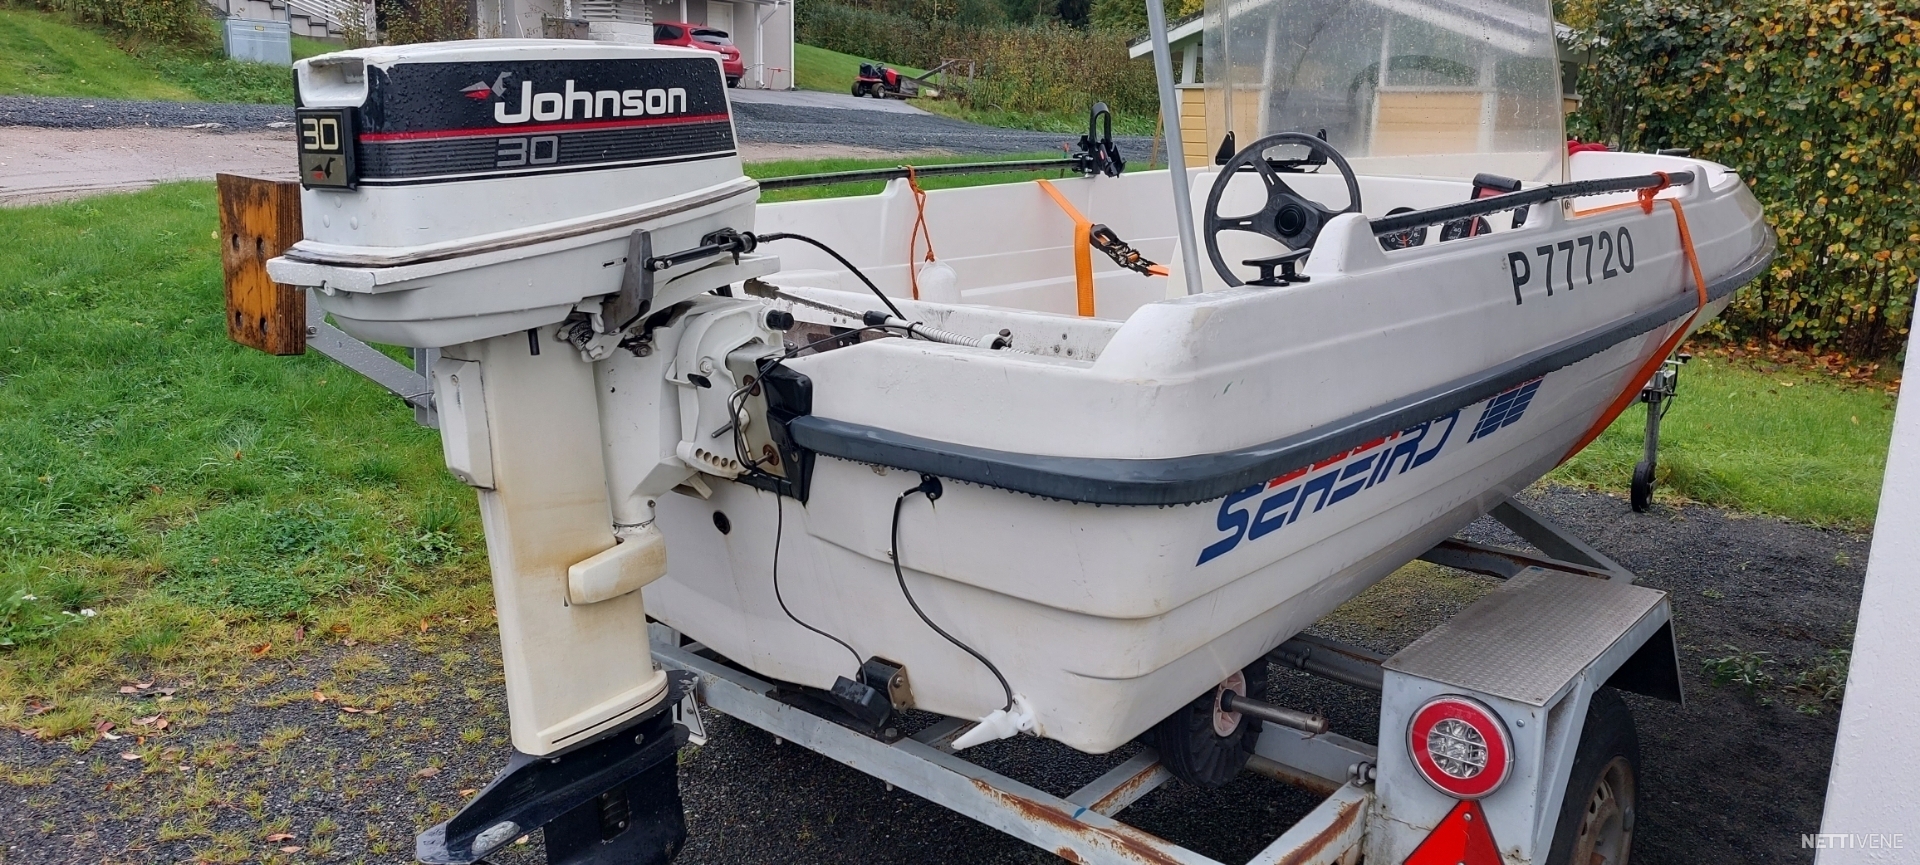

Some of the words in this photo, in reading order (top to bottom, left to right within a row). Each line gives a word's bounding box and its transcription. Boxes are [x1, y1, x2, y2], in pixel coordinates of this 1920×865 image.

[495, 80, 687, 123] Johnson
[302, 118, 339, 150] 30
[497, 136, 559, 166] 30
[1508, 251, 1531, 305] P
[1536, 226, 1635, 296] 77720
